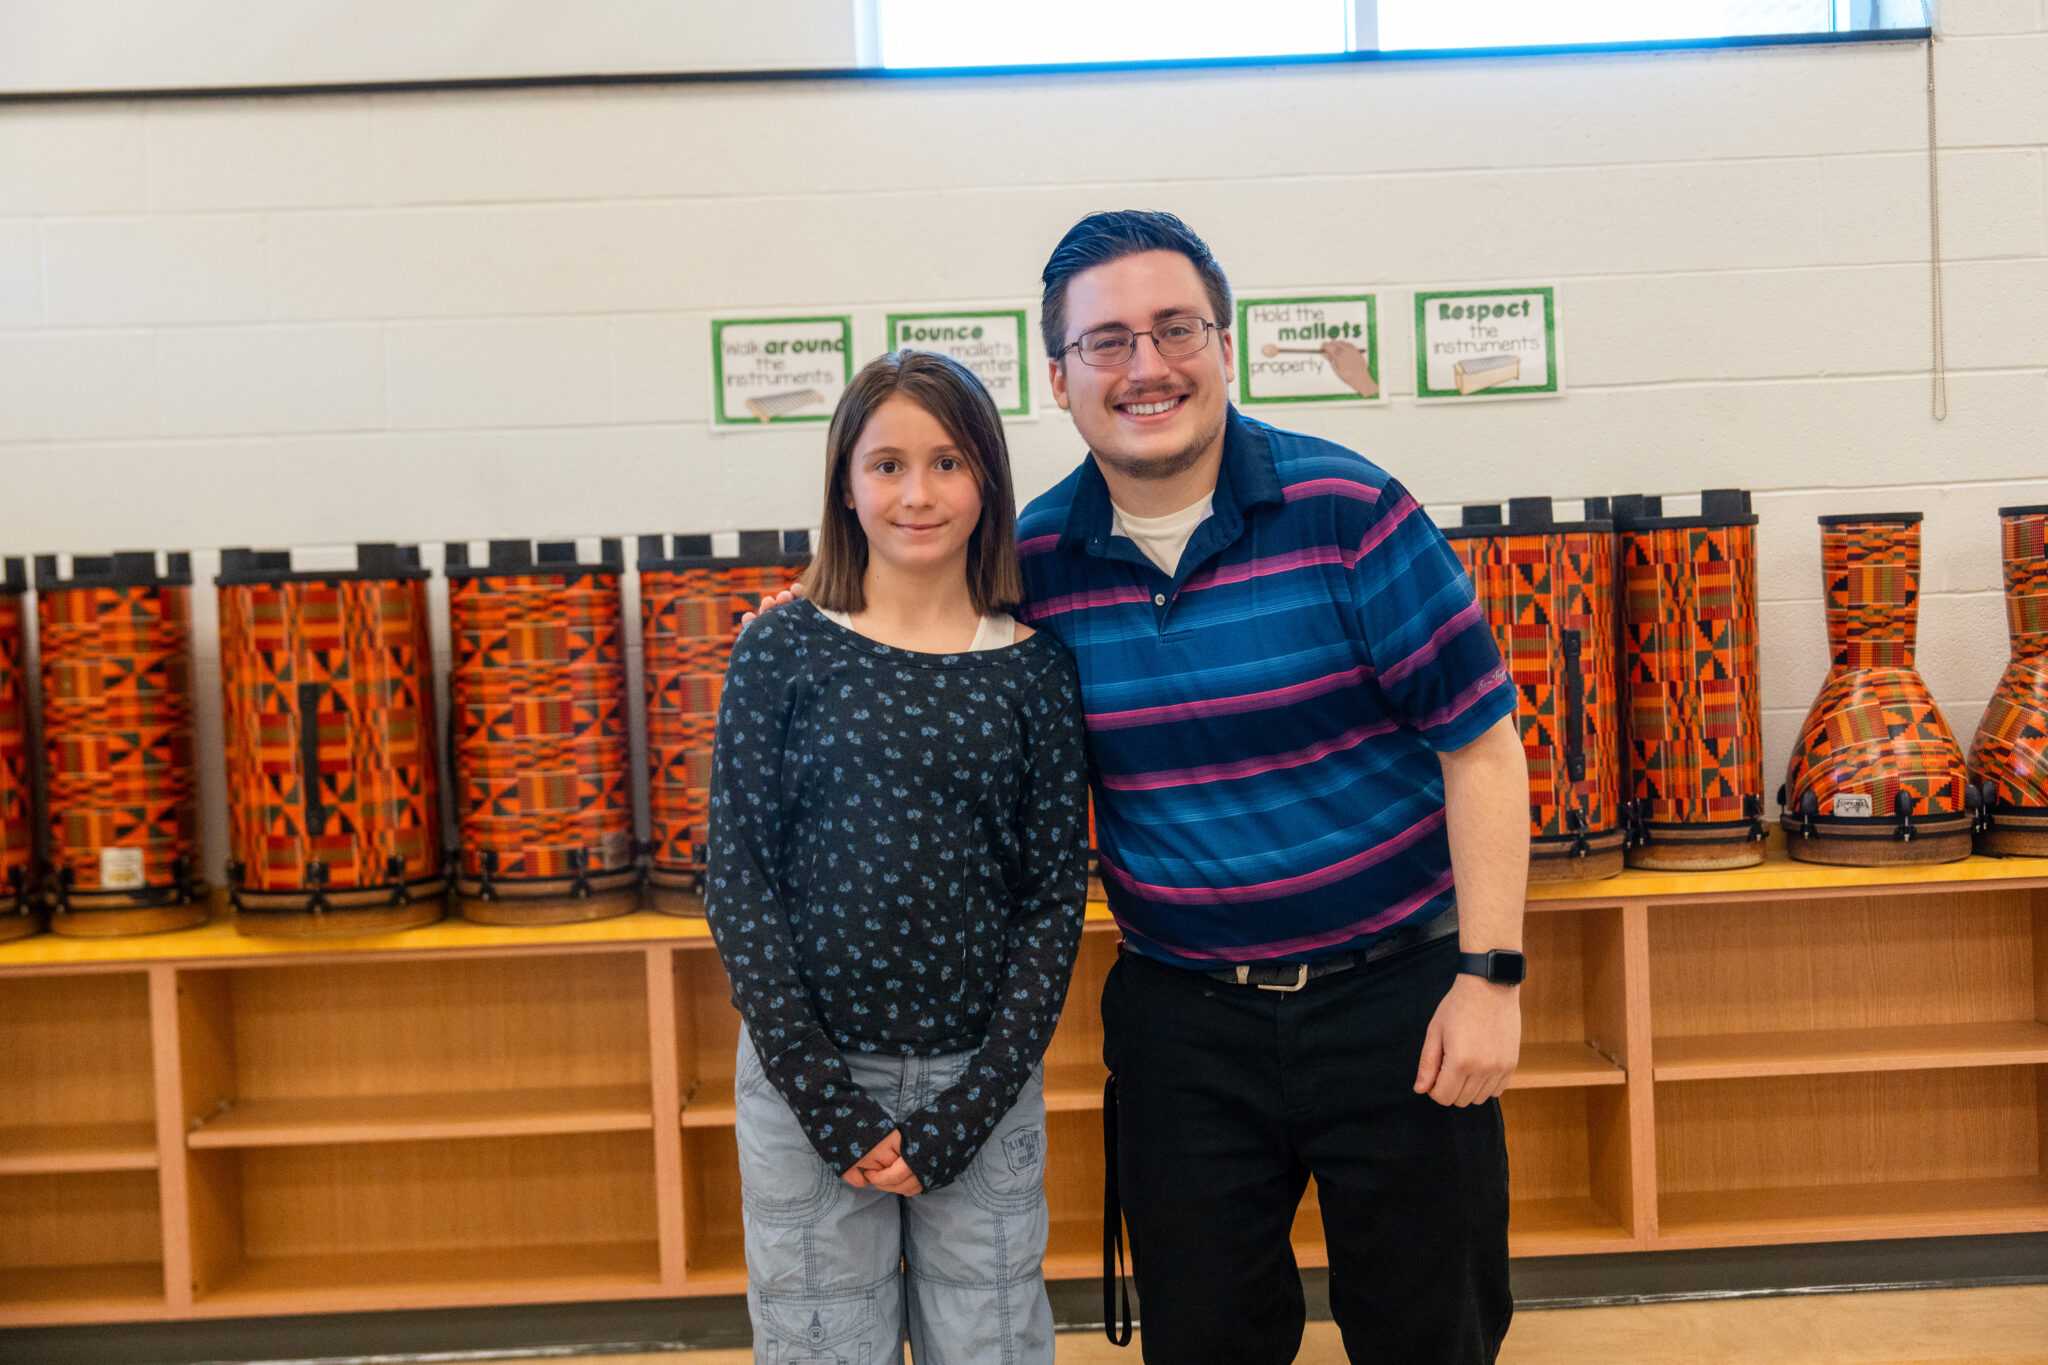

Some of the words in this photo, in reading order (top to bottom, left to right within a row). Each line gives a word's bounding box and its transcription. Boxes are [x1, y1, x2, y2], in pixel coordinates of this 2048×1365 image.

[1252, 306, 1290, 323] Hold
[1296, 306, 1325, 321] the
[1438, 298, 1531, 322] Respect
[901, 325, 983, 342] Bounce
[1278, 320, 1363, 341] mallets
[1469, 322, 1499, 338] the
[950, 342, 1013, 358] mallets
[1433, 335, 1540, 354] instruments
[756, 357, 784, 372] the
[969, 357, 1018, 373] enter
[1250, 356, 1324, 376] properly
[727, 369, 834, 387] instruments
